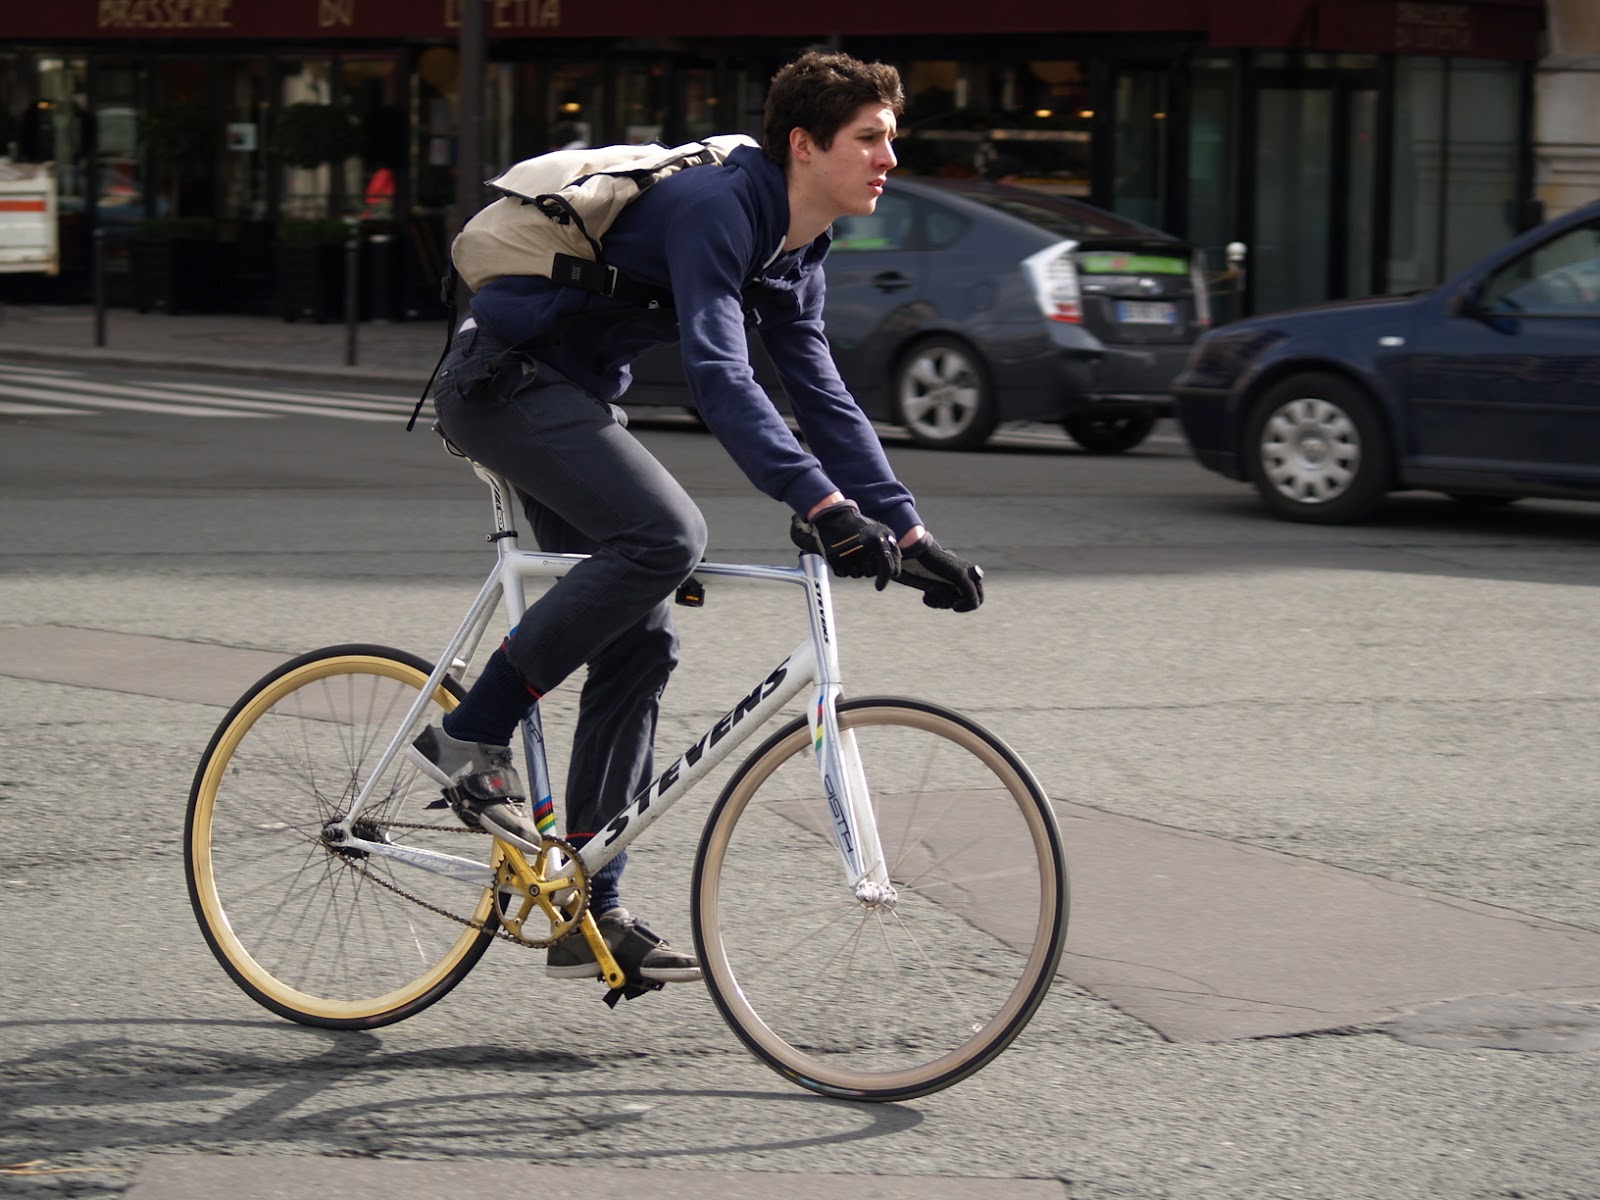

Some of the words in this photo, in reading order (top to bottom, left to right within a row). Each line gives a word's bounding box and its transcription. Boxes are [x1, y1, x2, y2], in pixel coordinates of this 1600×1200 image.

[97, 0, 232, 27] BRASSERIE
[814, 580, 830, 645] STEVENS
[605, 655, 792, 847] STEVENS
